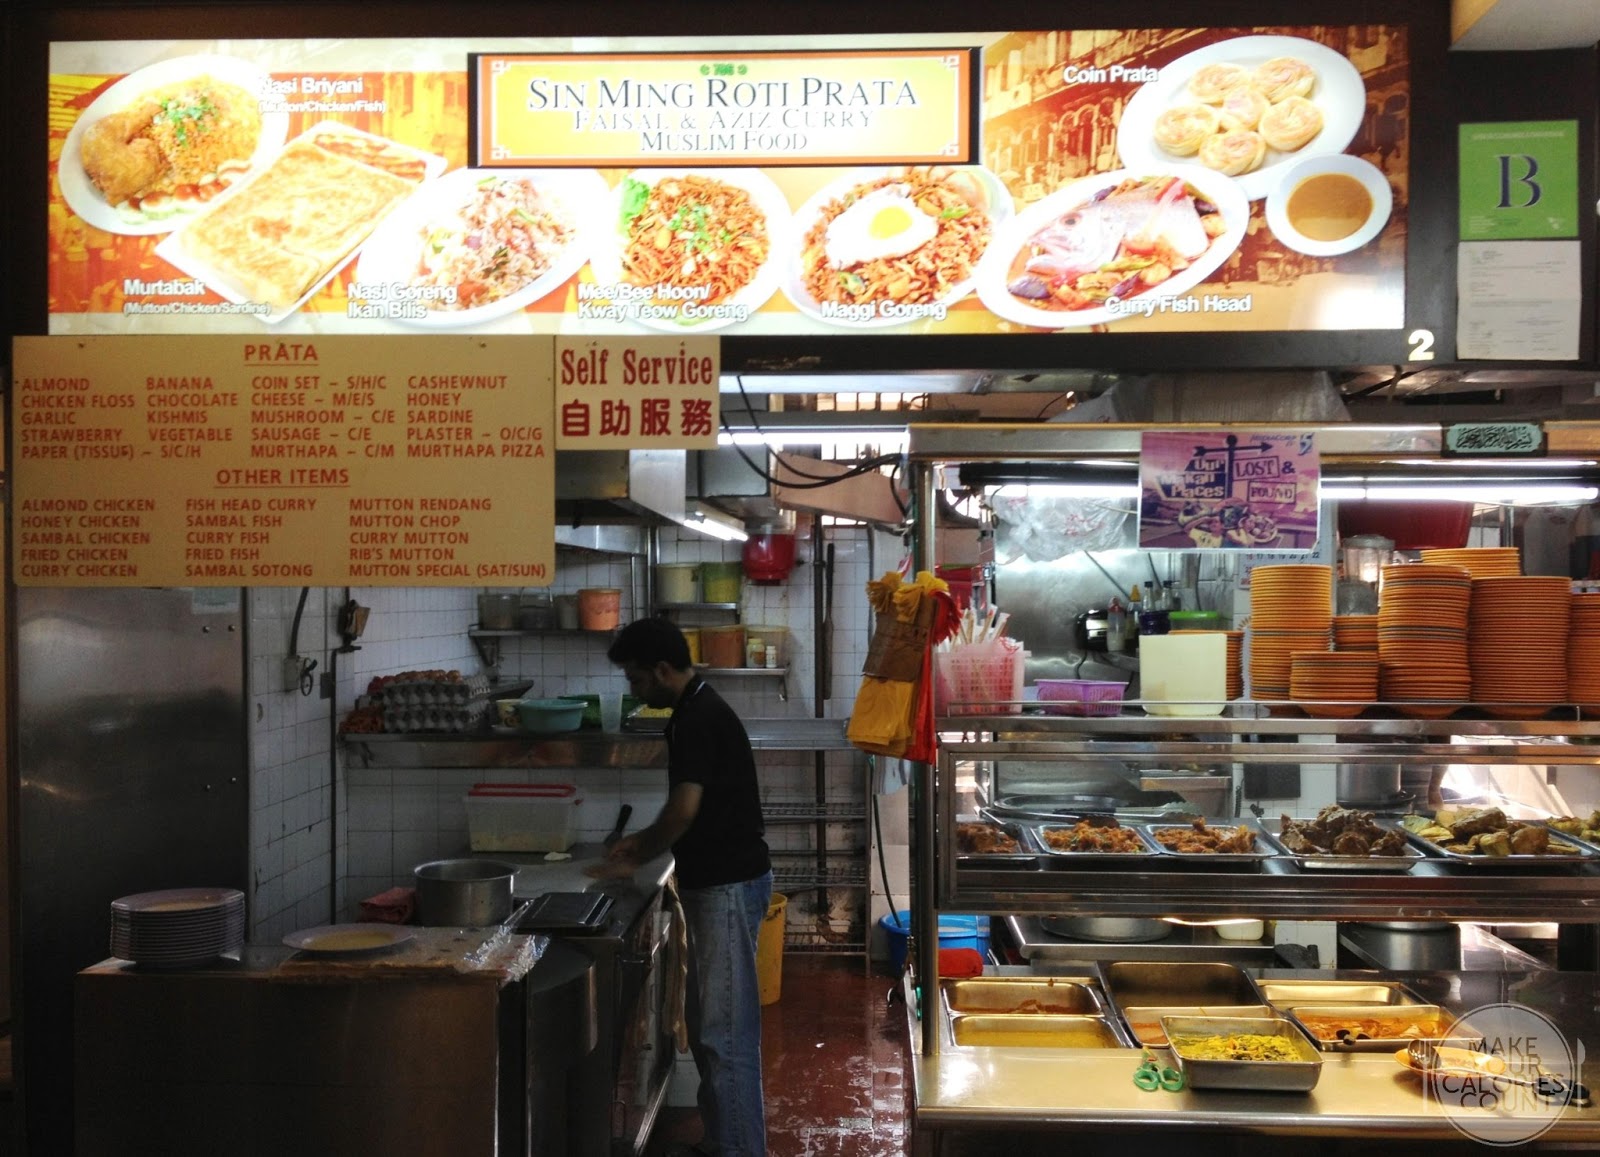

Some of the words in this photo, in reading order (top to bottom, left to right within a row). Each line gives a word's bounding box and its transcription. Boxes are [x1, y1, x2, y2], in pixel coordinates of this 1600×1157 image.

[1063, 65, 1107, 83] Coin
[1109, 65, 1158, 83] Prata
[260, 76, 298, 94] Nasi
[301, 76, 363, 97] Briyani
[529, 79, 585, 109] SIN
[599, 78, 694, 108] MING
[707, 78, 788, 108] ROTI
[801, 77, 918, 107] PRATA
[575, 109, 668, 130] FAISAL
[680, 112, 697, 130] &
[709, 109, 773, 129] AZIZ
[783, 108, 874, 129] CURRY
[641, 130, 736, 152] MUSLIM
[743, 129, 808, 151] FOOD
[1494, 153, 1542, 209] B
[124, 277, 206, 295] Murtabak
[347, 282, 387, 300] Nasi
[390, 281, 458, 304] Goreng
[577, 283, 653, 300] Mee/Bee
[656, 283, 711, 300] Hoon/
[124, 301, 272, 317] (Mutton/Chicken/Sardine)
[347, 301, 385, 318] Ikan
[388, 301, 427, 319] Bilis
[577, 301, 627, 322] Kway
[631, 301, 679, 319] Teow
[681, 301, 749, 322] Goreng
[821, 300, 876, 321] Maggi
[879, 300, 948, 321] Goreng
[1105, 295, 1157, 317] Curry
[1160, 294, 1200, 313] Fish
[1203, 294, 1252, 313] Head
[244, 344, 319, 361] PRATA
[1408, 329, 1435, 362] 2
[561, 349, 608, 386] Self
[623, 348, 713, 385] Service
[22, 378, 90, 391] ALMOND
[146, 377, 213, 390] BANANA
[252, 376, 288, 390] COIN
[295, 376, 319, 390] SET
[347, 376, 387, 390] S/H/C
[408, 376, 507, 390] CASHEWNUT
[22, 394, 86, 409] CHICKEN
[91, 394, 135, 408] FLOSS
[147, 393, 238, 408] CHOCOLATE
[252, 393, 305, 406] CHEESE
[333, 393, 375, 406] M/E/S
[407, 393, 462, 406] HONEY
[22, 411, 76, 425] GARLIC
[147, 410, 208, 424] KISHMIS
[252, 410, 344, 423] MUSHROOM
[371, 410, 396, 424] C/E
[407, 410, 473, 423] SARDINE
[561, 398, 712, 437] 自助服務
[22, 429, 123, 442] STRAWBERRY
[149, 427, 233, 441] VEGETABLE
[252, 427, 321, 441] SAUSAGE
[347, 427, 371, 441] C/E
[407, 427, 473, 441] PLASTER
[500, 427, 543, 441] O/C/G
[22, 446, 67, 459] PAPER
[161, 445, 201, 458] S/C/H
[251, 444, 338, 458] MURTHAPA
[365, 444, 395, 458] C/M
[407, 444, 495, 457] MURTHAPA
[502, 444, 544, 458] PIZZA
[1235, 459, 1275, 477] LOST
[1281, 461, 1296, 475] &
[216, 469, 282, 485] OTHER
[289, 469, 350, 484] ITEMS
[1172, 485, 1225, 497] Places
[1251, 486, 1293, 499] FOUND
[22, 499, 88, 512] ALMOND
[94, 498, 155, 511] CHICKEN
[186, 499, 215, 511] FISH
[222, 499, 262, 511] HEAD
[268, 499, 317, 511] CURRY
[350, 498, 414, 511] MUTTON
[420, 498, 492, 511] RENDANG
[22, 516, 72, 528] HONEY
[79, 515, 140, 528] CHICKEN
[187, 515, 247, 528] SAMBAL
[253, 515, 282, 528] FISH
[350, 515, 414, 528] MUTTON
[420, 515, 461, 528] CHOP
[22, 532, 83, 545] SAMBAL
[89, 532, 151, 545] CHICKEN
[187, 532, 234, 544] CURRY
[241, 532, 270, 544] FISH
[350, 532, 398, 544] CURRY
[404, 532, 469, 544] MUTTON
[22, 549, 60, 561] FRIED
[67, 548, 128, 561] CHICKEN
[186, 548, 224, 561] FRIED
[231, 548, 260, 560] FISH
[350, 548, 383, 561] RIB'S
[389, 548, 454, 560] MUTTON
[22, 565, 70, 577] CURRY
[76, 564, 138, 577] CHICKEN
[186, 564, 246, 577] SAMBAL
[252, 564, 313, 577] SOTONG
[350, 564, 410, 577] MUTTON
[416, 564, 470, 577] SPECIAL
[476, 563, 546, 579] (SAT/SUN)
